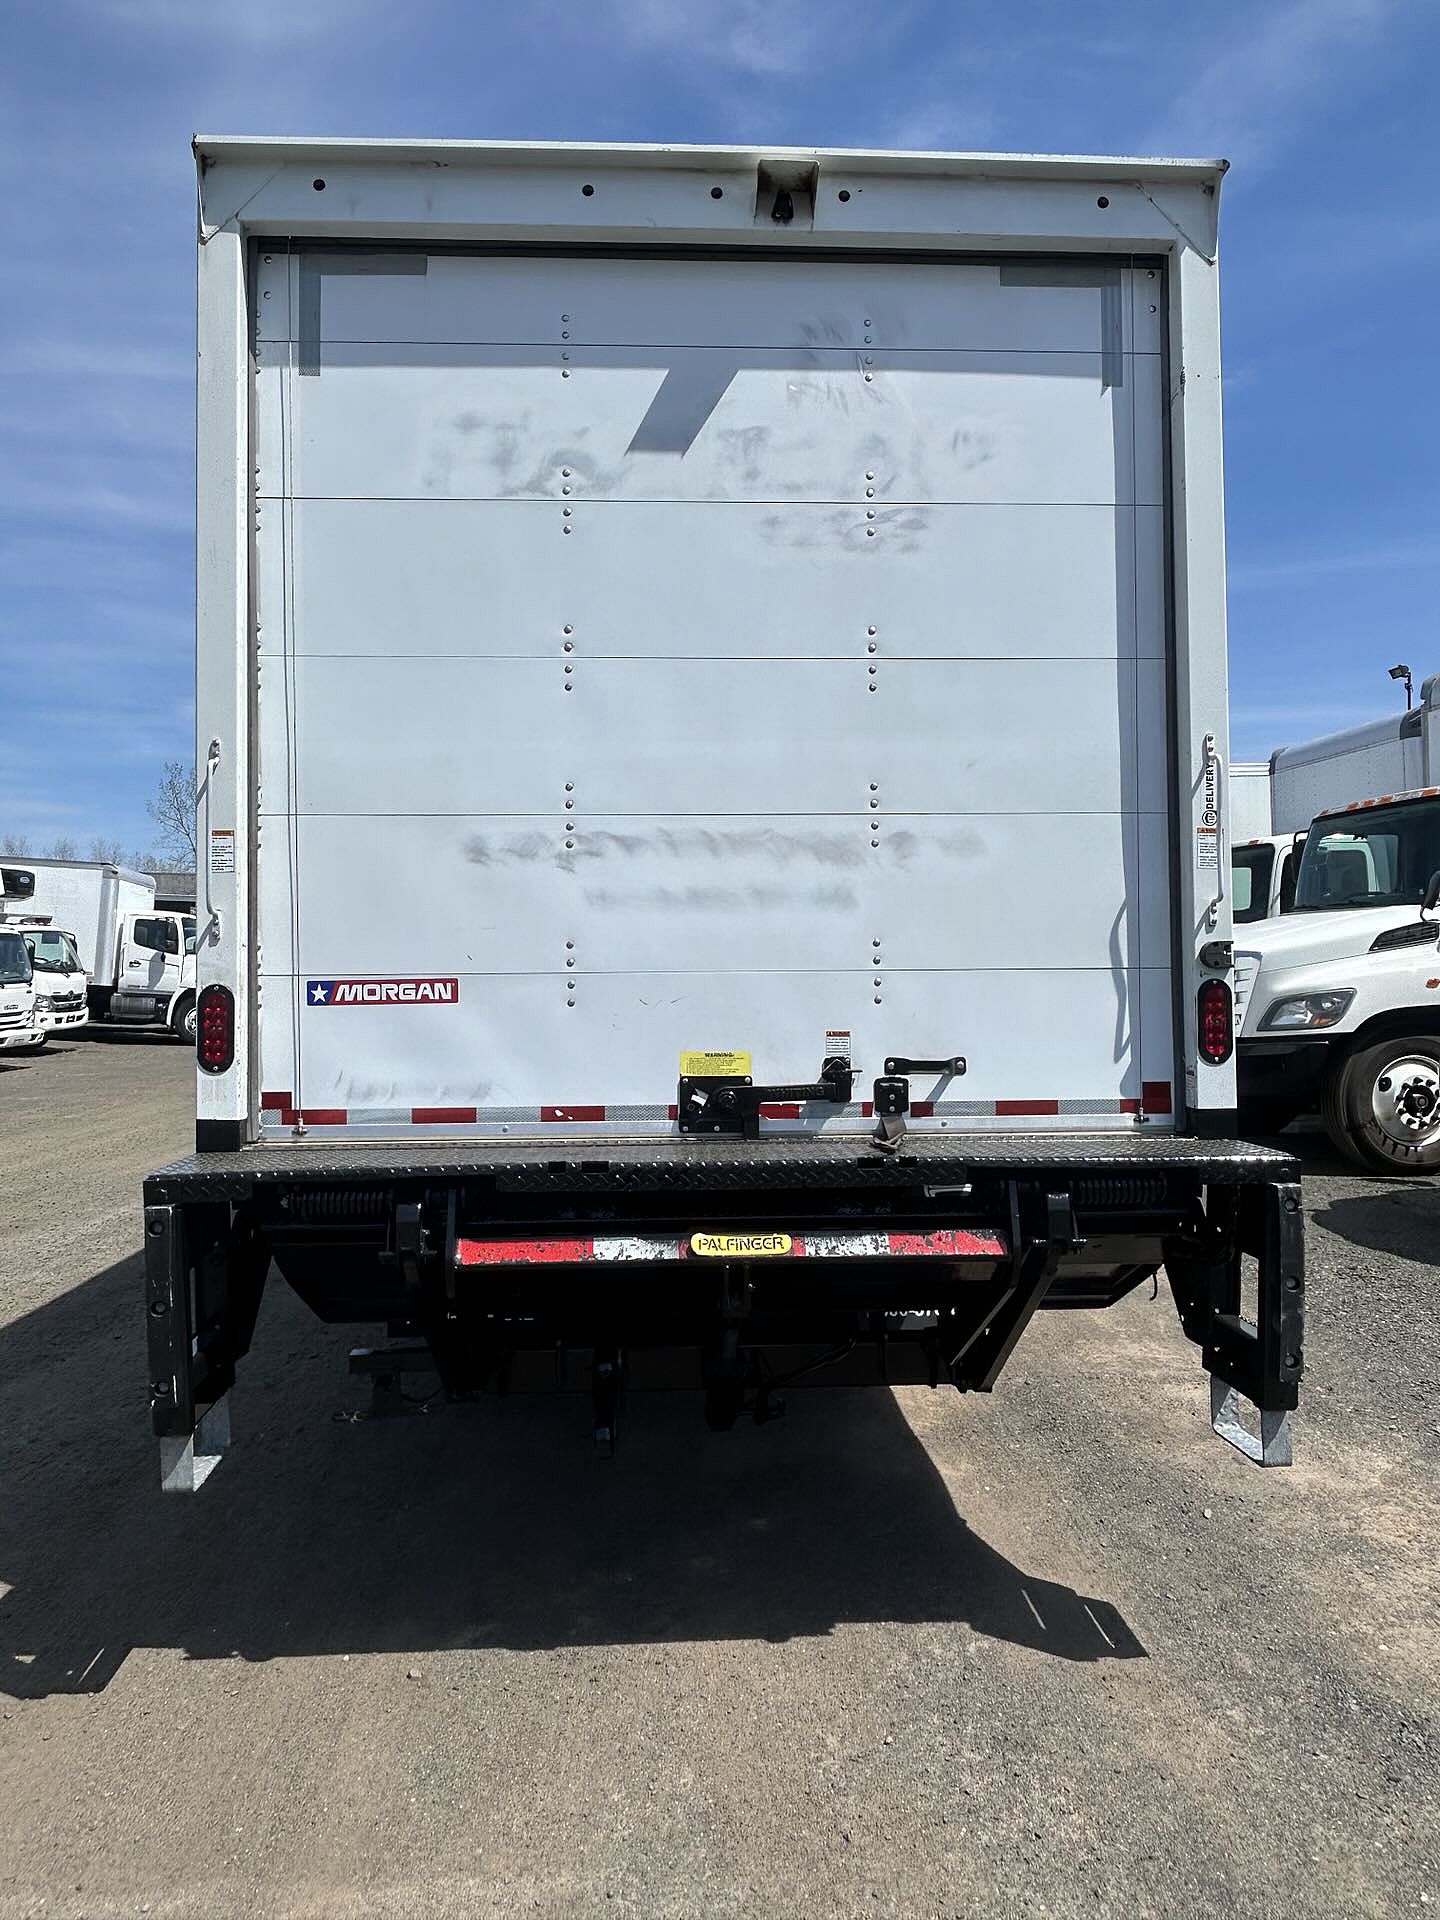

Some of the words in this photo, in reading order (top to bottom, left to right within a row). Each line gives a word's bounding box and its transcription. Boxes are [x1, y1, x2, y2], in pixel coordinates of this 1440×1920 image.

[1205, 763, 1214, 809] DELIVERY
[335, 982, 452, 1001] MORGAN
[698, 1236, 785, 1251] PALFINGER
